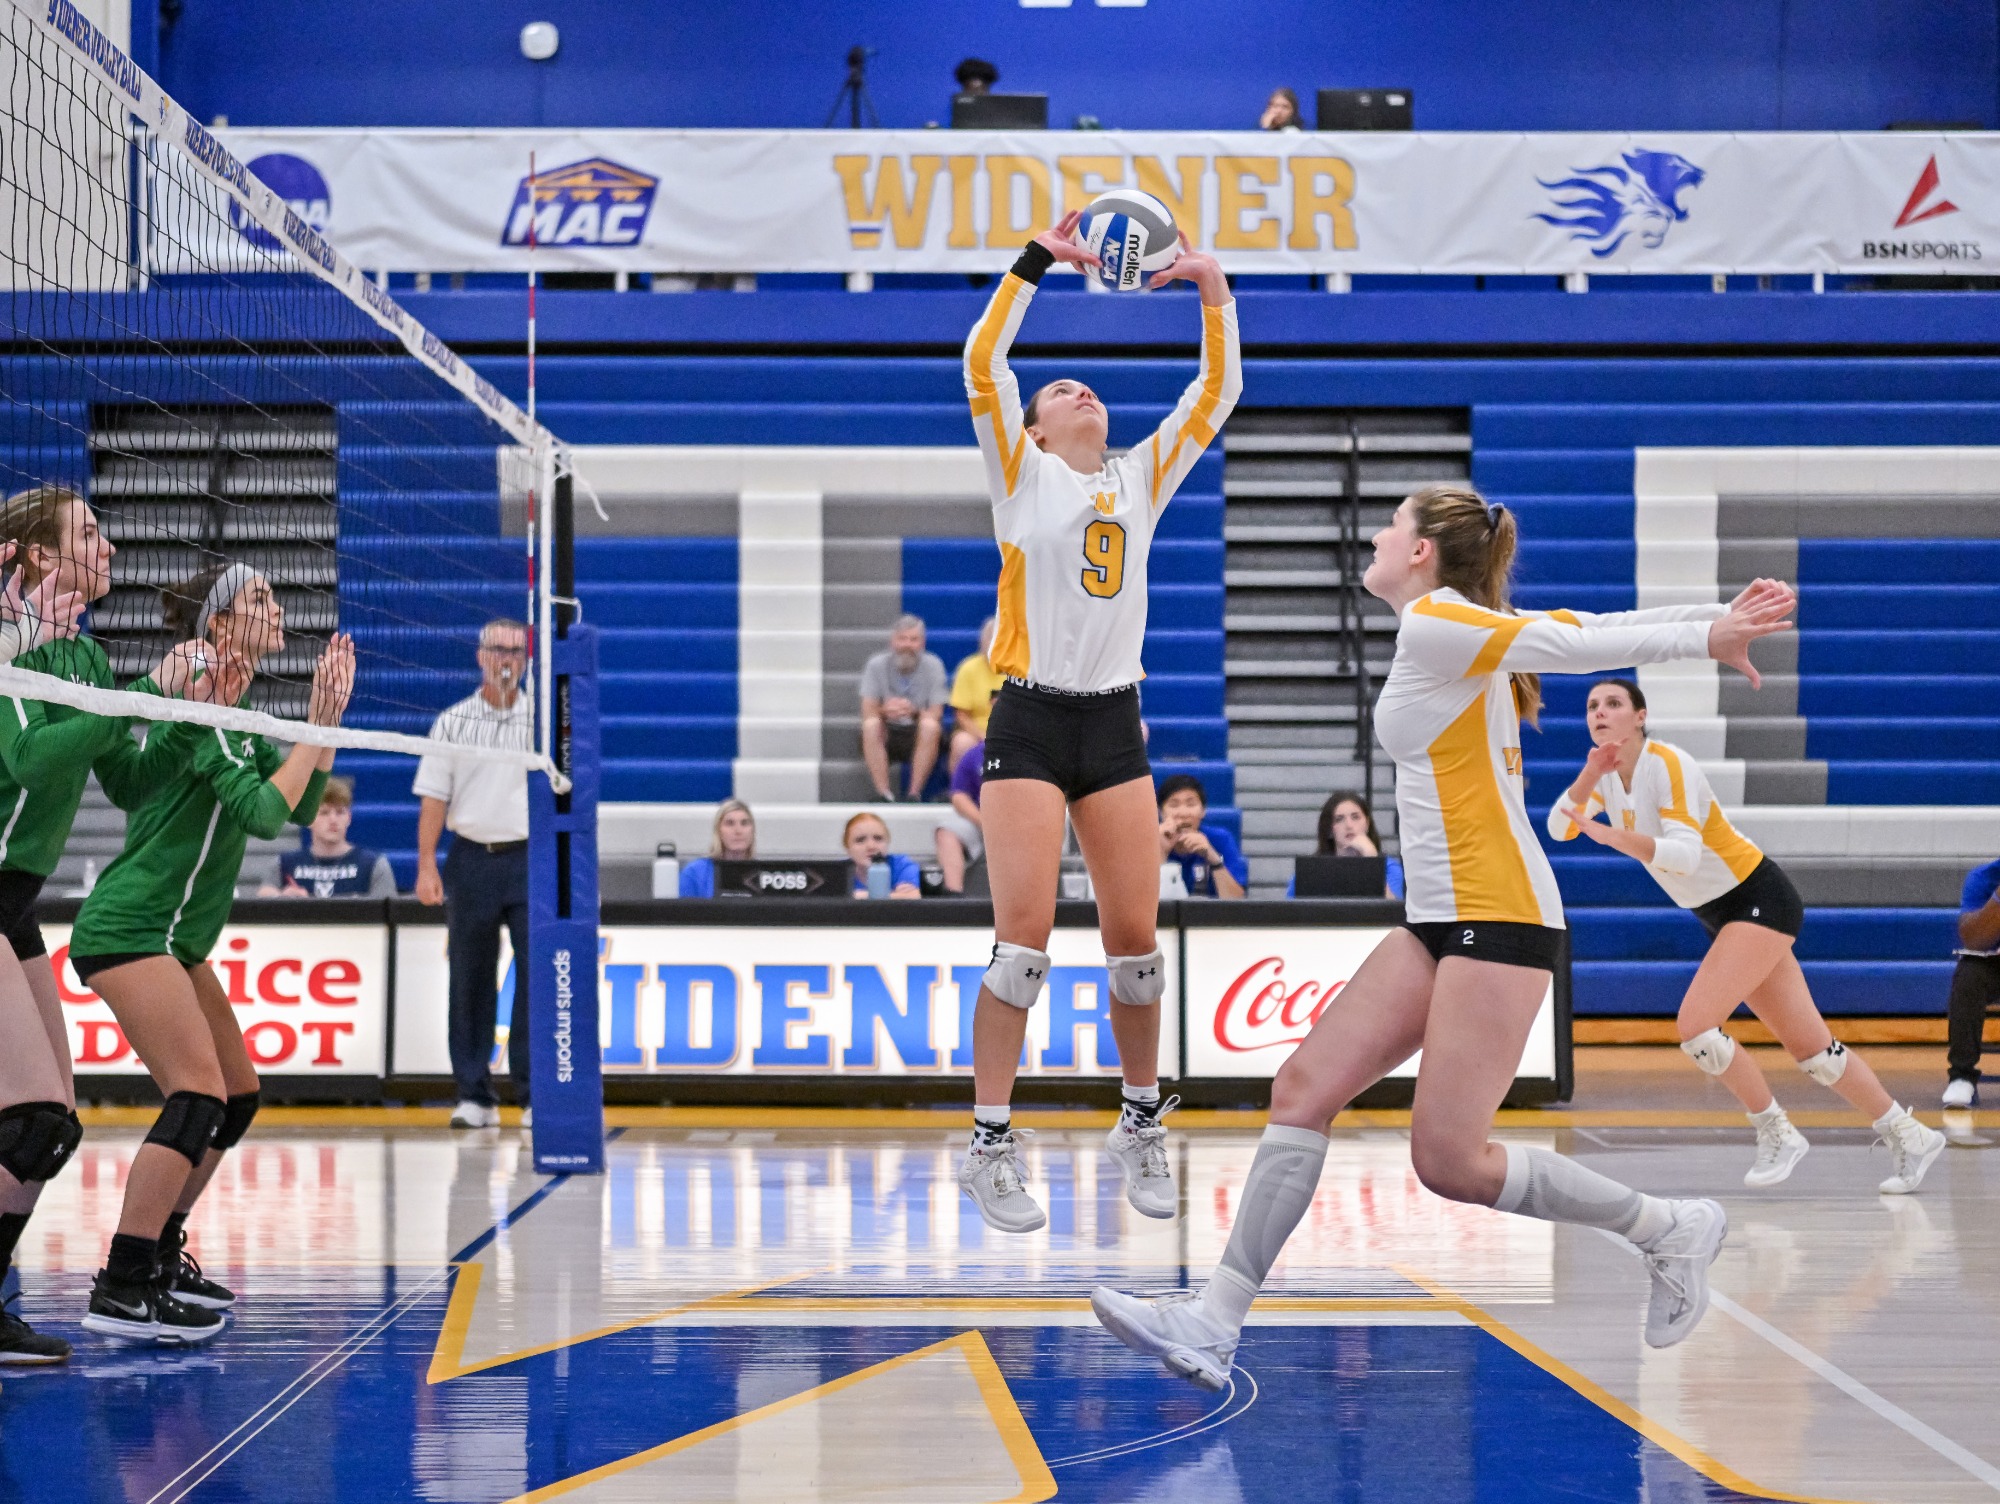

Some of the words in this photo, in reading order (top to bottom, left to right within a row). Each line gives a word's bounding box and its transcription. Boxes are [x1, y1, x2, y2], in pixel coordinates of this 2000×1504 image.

[508, 203, 648, 245] MAC
[1122, 234, 1141, 286] molten
[1863, 242, 1908, 259] BSN
[1911, 242, 1983, 260] SPORTS
[1081, 519, 1127, 600] 9
[759, 872, 808, 890] POSS
[1462, 929, 1475, 945] 2
[51, 937, 361, 1007] Oice
[552, 949, 573, 1009] sports
[444, 935, 1122, 1071] IDENR
[75, 1020, 355, 1066] DOT
[553, 1011, 575, 1083] imports
